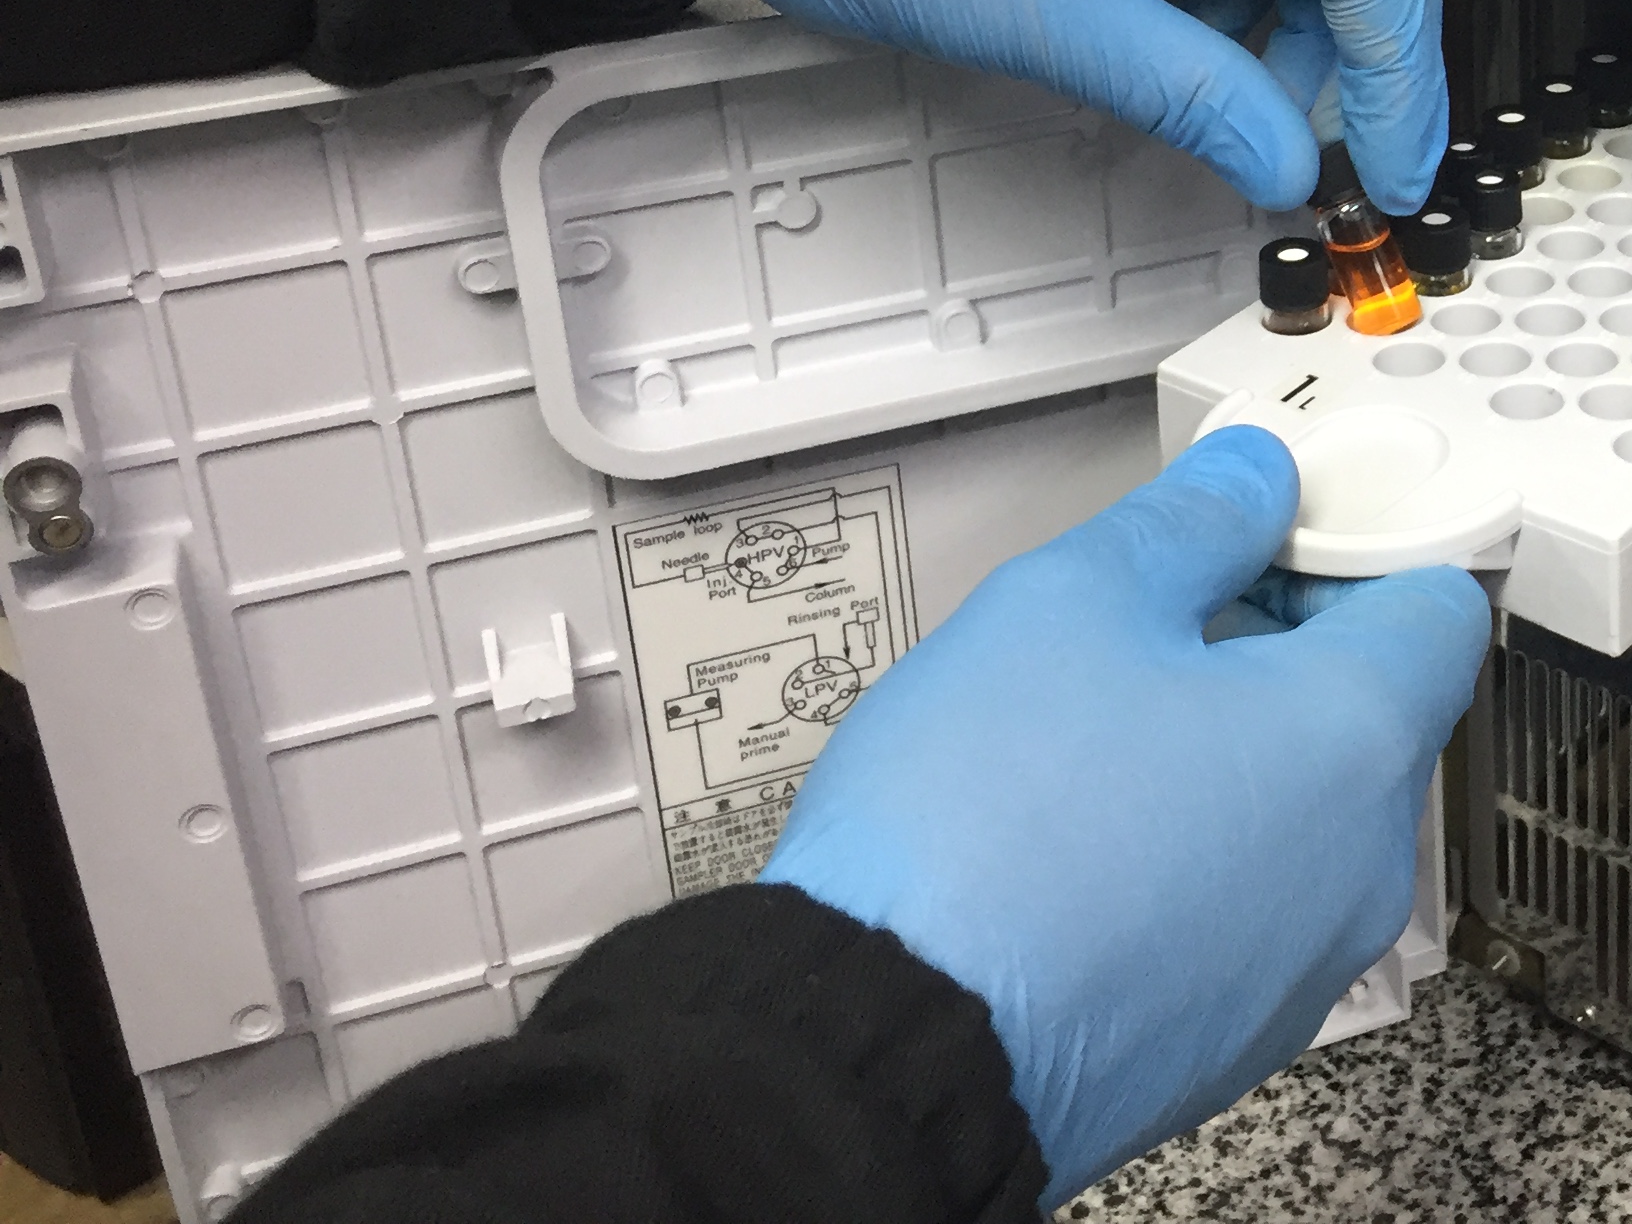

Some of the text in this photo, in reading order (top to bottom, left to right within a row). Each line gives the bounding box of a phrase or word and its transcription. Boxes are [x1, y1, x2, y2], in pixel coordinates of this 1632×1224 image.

[633, 521, 723, 550] Sample loop
[747, 545, 785, 565] HPV
[811, 541, 851, 558] Pump
[661, 551, 710, 571] Needle
[709, 586, 737, 601] Port
[804, 583, 856, 603] Column
[787, 596, 880, 627] Rinsing Port
[694, 652, 771, 677] Measuring
[697, 672, 738, 688] Pump
[804, 679, 838, 699] LPV
[738, 727, 790, 748] Manual
[740, 743, 780, 761] prime
